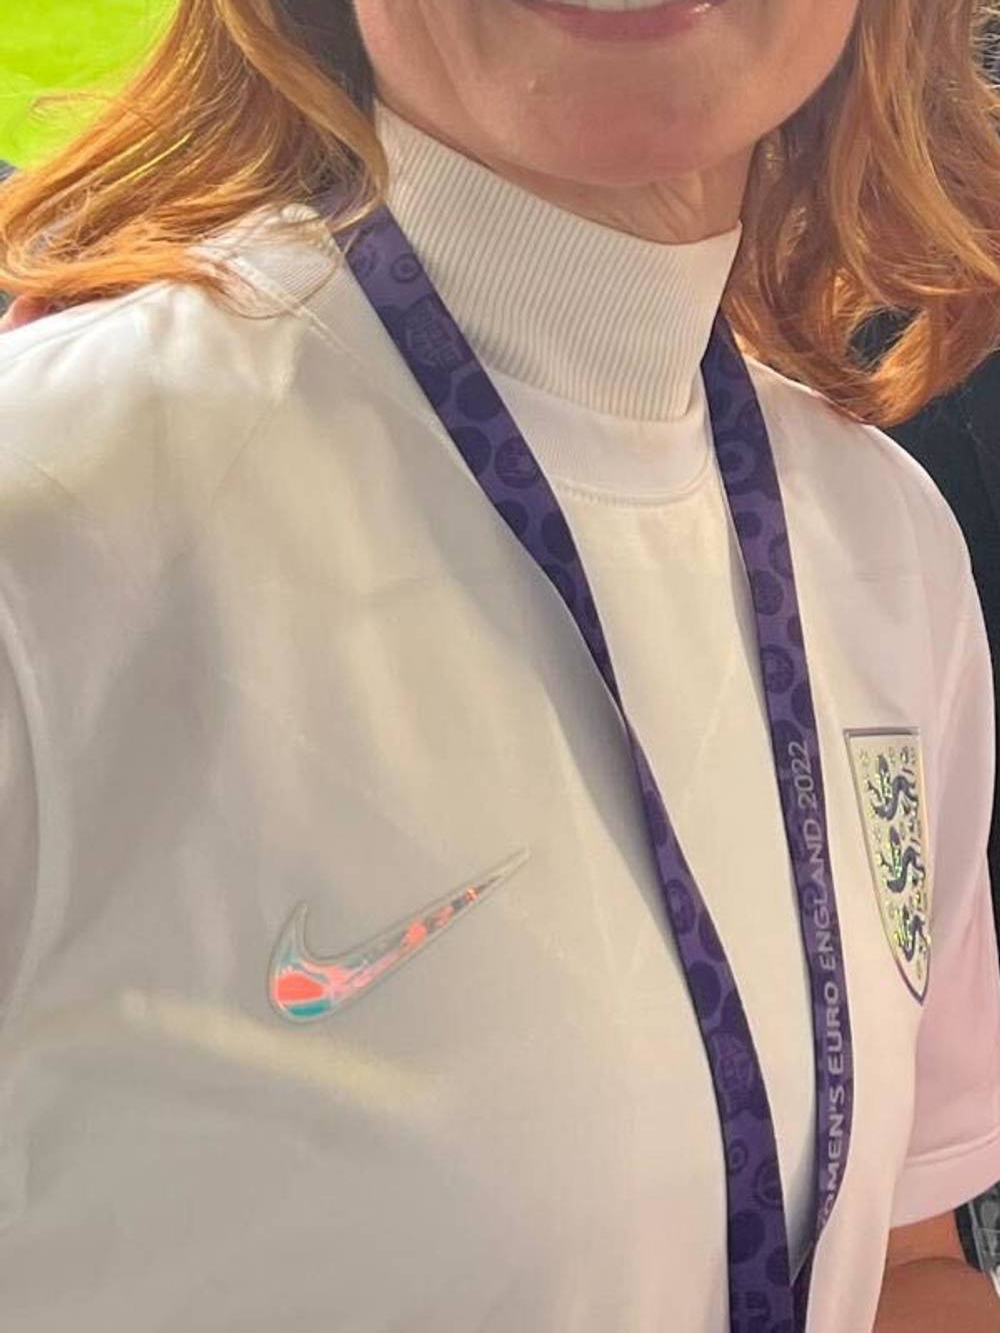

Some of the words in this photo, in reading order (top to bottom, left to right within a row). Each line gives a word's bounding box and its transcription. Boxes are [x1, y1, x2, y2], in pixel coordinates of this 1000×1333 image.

[788, 740, 817, 811] 2022
[803, 818, 837, 971] ENGLAND
[824, 981, 845, 1076] EURO
